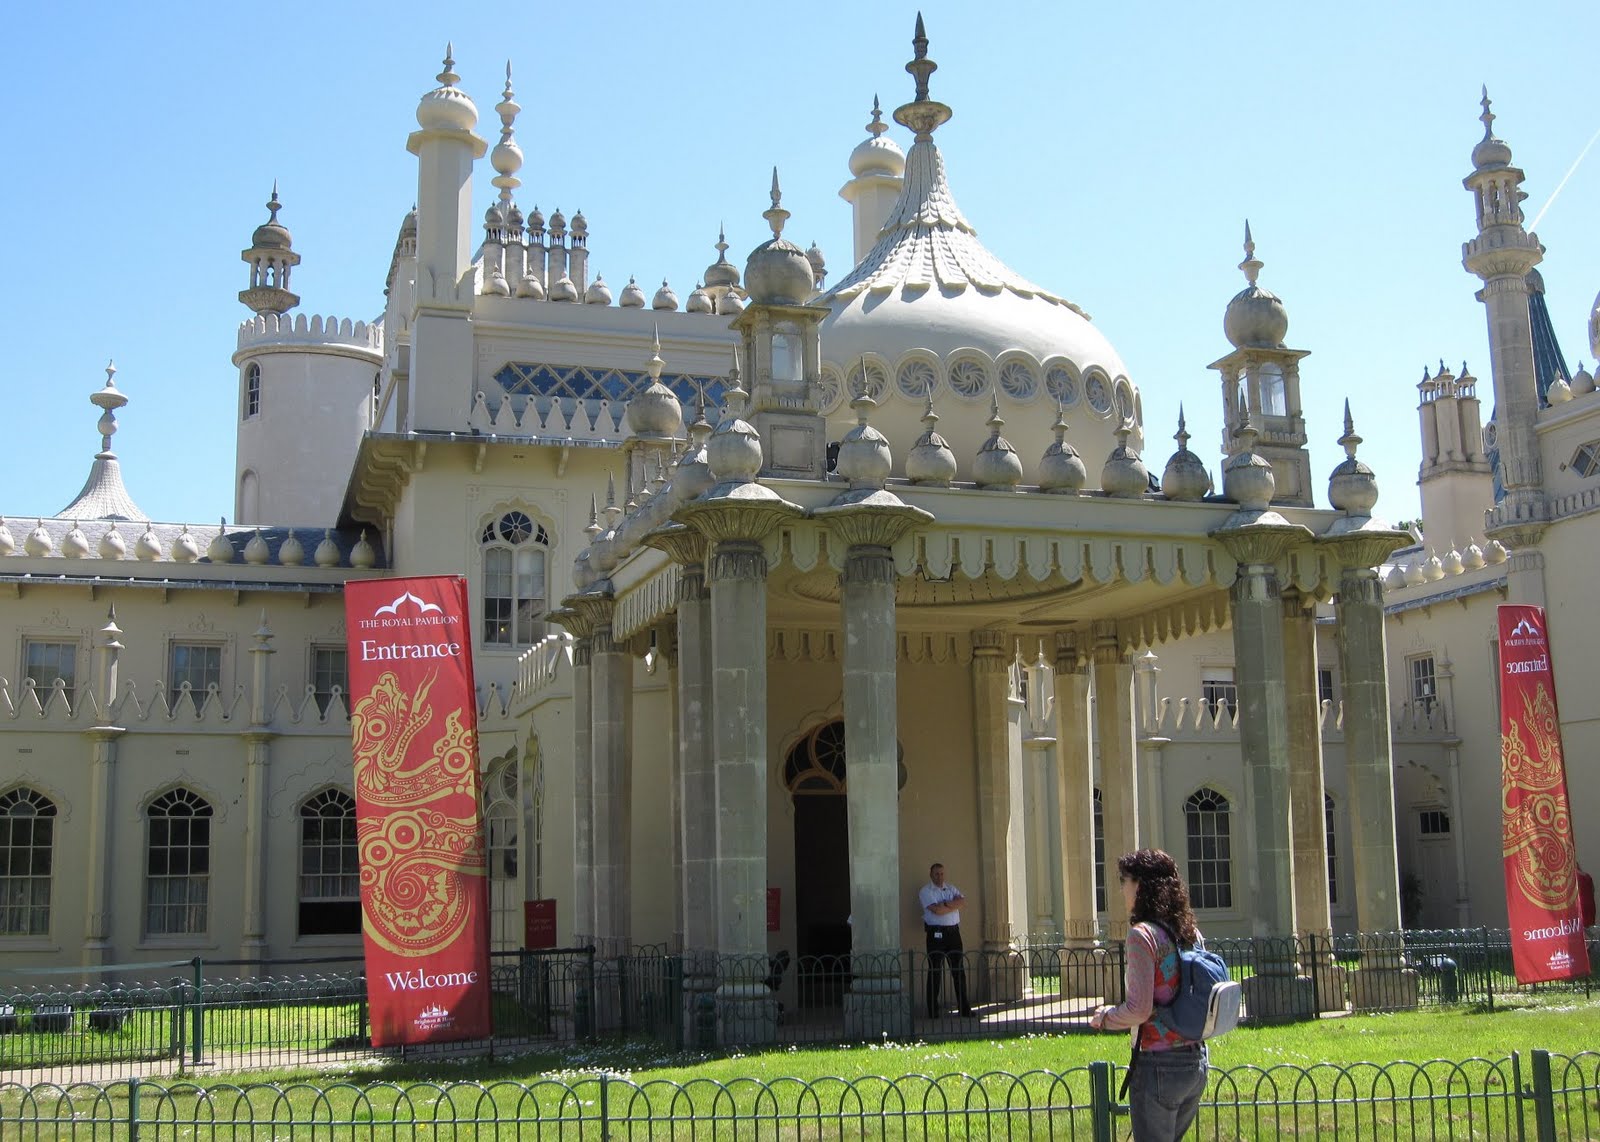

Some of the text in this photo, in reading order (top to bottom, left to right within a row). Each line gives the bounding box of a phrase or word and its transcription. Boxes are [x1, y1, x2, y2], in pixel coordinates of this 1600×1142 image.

[359, 616, 458, 628] THE ROYAL PAVILION
[361, 639, 460, 661] Entrance
[385, 968, 478, 991] Welcome
